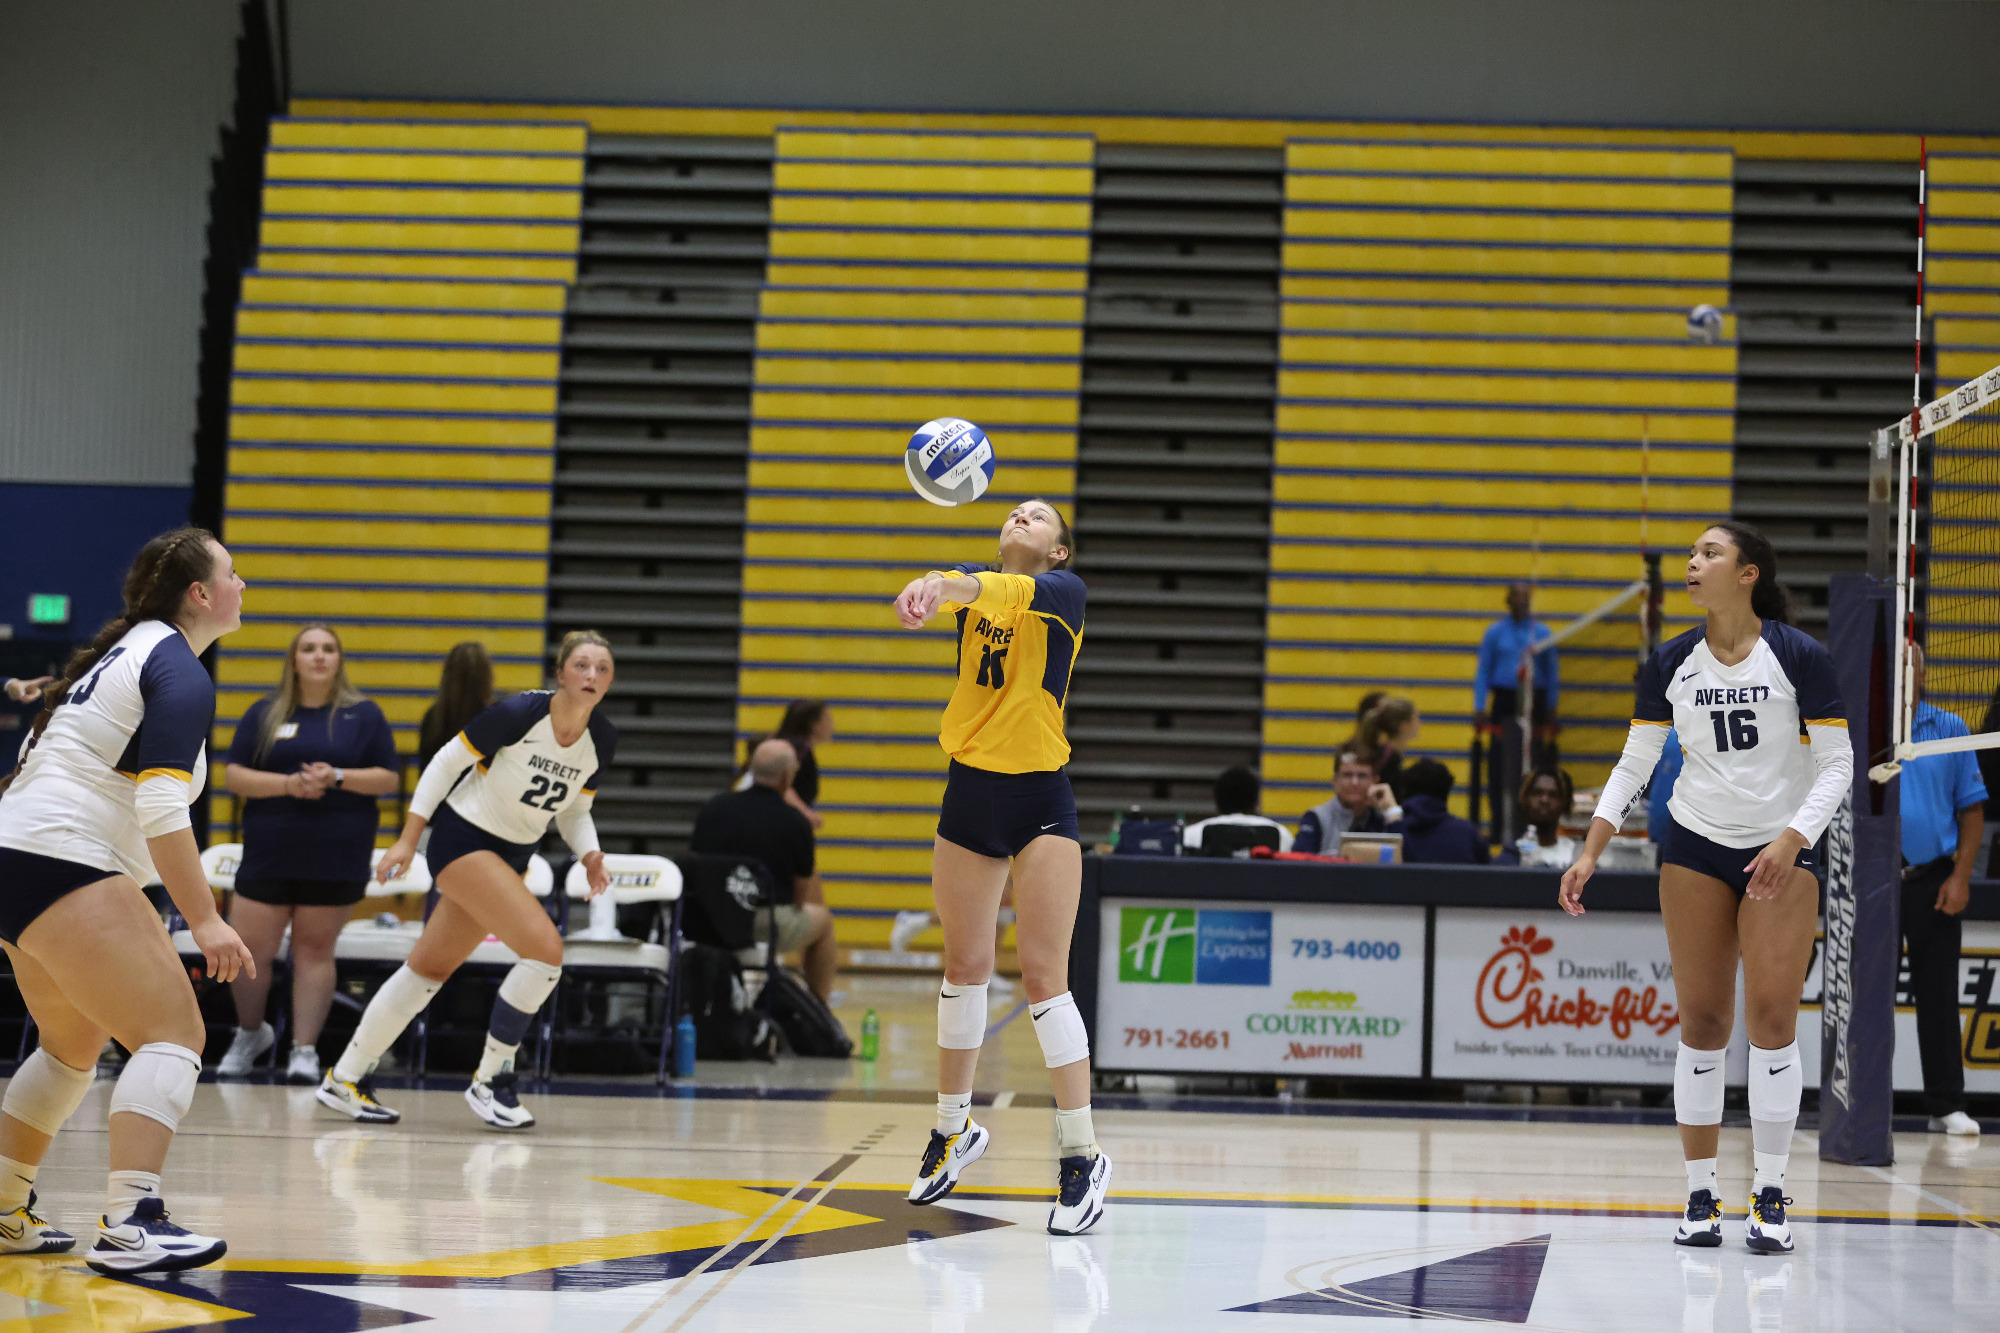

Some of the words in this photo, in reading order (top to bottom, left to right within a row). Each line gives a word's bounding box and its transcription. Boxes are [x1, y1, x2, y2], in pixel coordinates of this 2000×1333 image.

[926, 423, 966, 459] molten
[1695, 686, 1770, 706] AVERETT
[1710, 709, 1759, 752] 16
[528, 754, 582, 781] AVERETT
[519, 775, 569, 812] 22
[1620, 803, 1631, 819] ONE
[1292, 938, 1400, 961] 793-4000
[1246, 1013, 1400, 1037] COURTYARD
[1124, 1029, 1230, 1050] 791-2661
